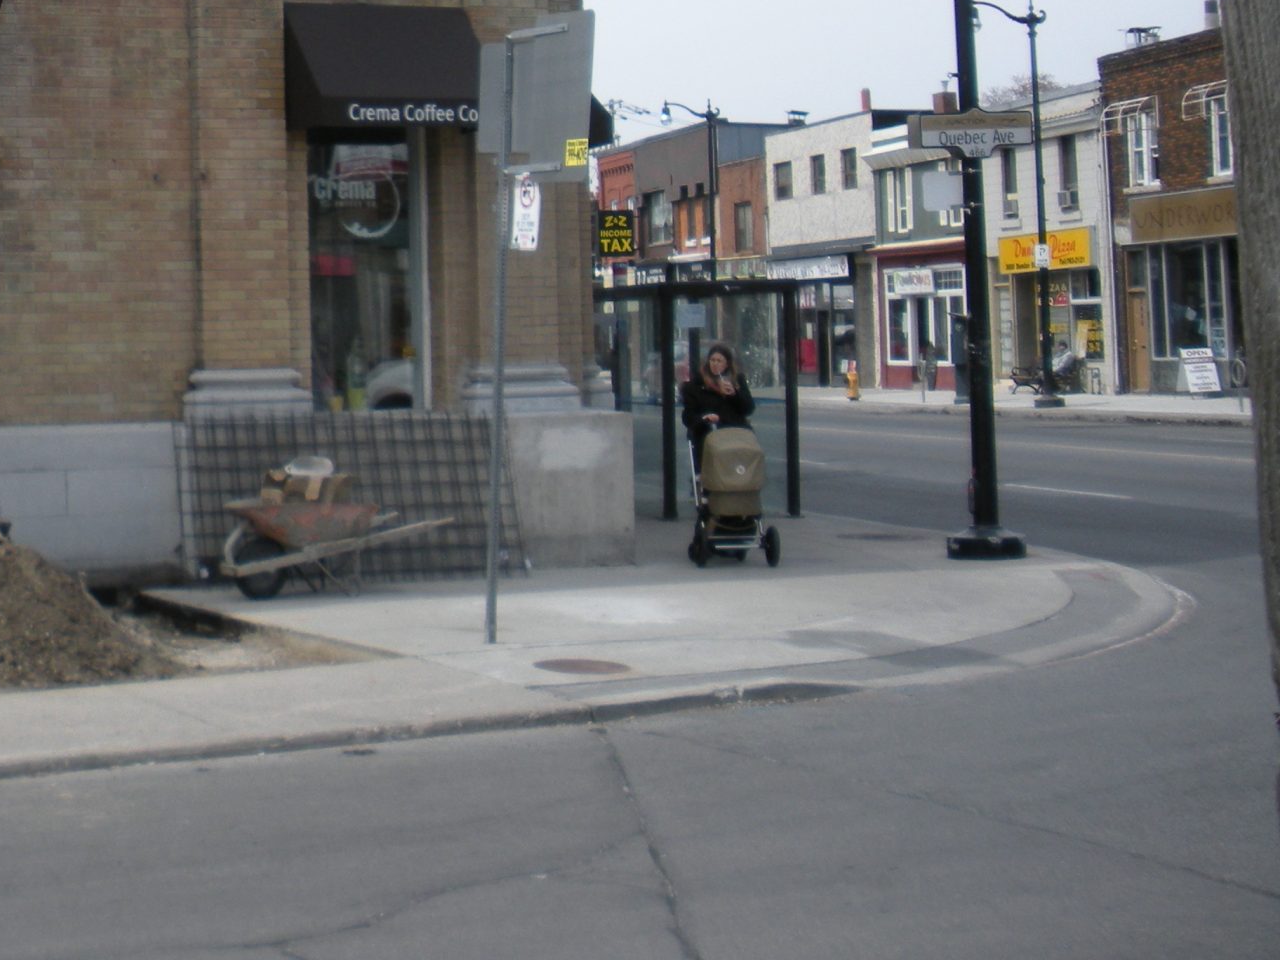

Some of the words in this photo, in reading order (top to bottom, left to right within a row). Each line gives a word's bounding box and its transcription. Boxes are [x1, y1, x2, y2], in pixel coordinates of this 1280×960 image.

[349, 103, 400, 121] Crema
[404, 104, 454, 122] Coffee
[939, 130, 987, 145] Quebec
[993, 129, 1015, 143] Ave
[600, 230, 632, 238] INCOME
[600, 238, 632, 253] TAX
[1048, 234, 1076, 259] Pizza
